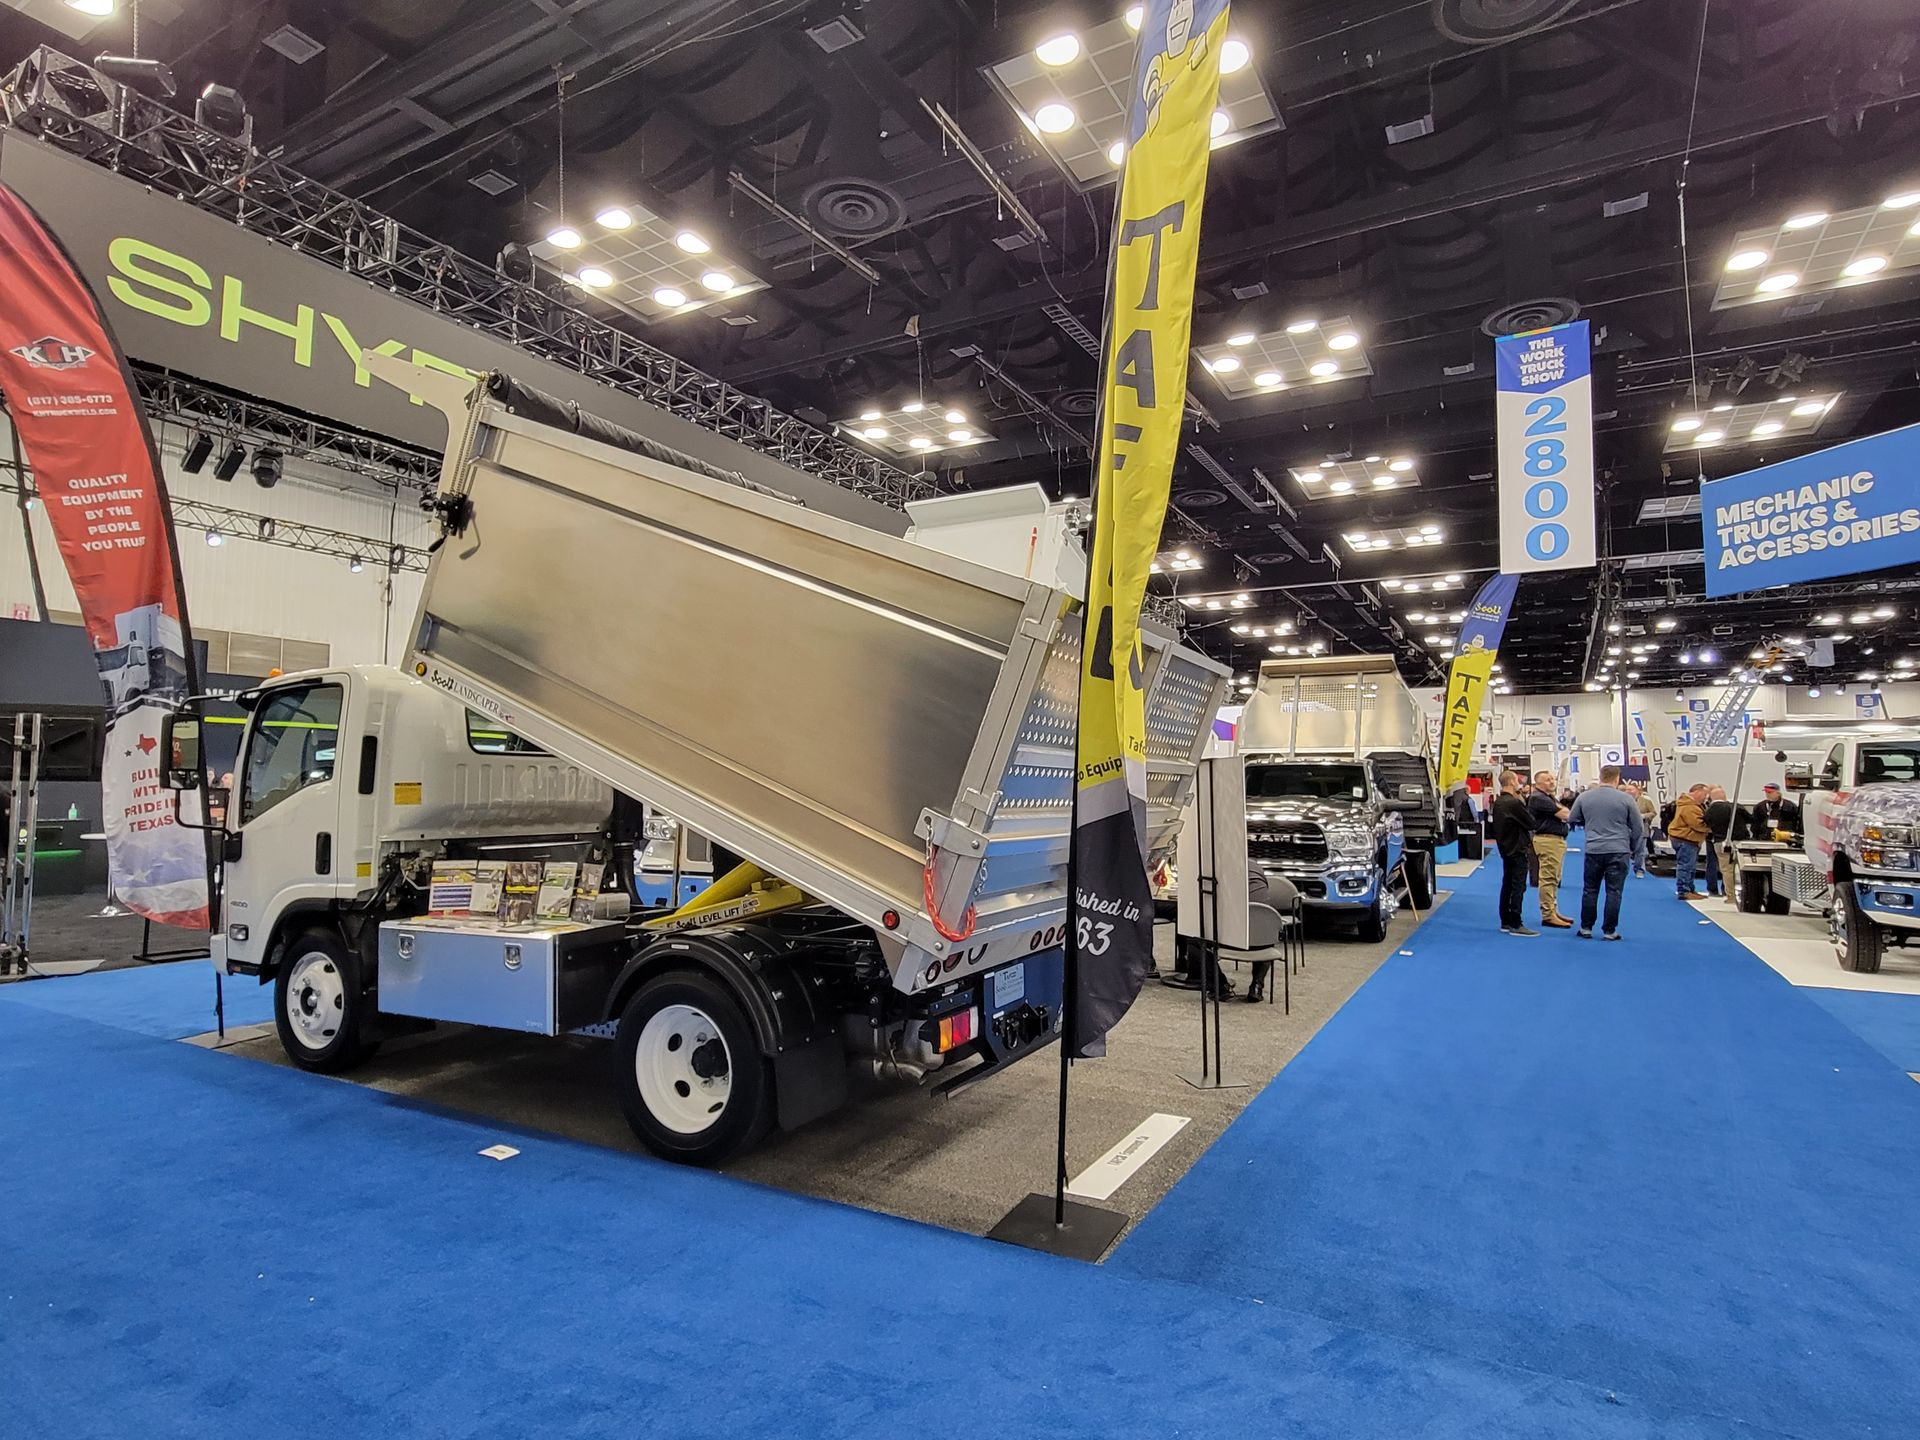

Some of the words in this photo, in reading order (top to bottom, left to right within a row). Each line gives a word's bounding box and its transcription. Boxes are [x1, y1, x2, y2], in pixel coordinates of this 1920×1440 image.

[1528, 337, 1555, 351] THE
[1520, 347, 1565, 363] WORK
[1520, 358, 1565, 375] TRUCK
[1521, 369, 1565, 387] SHOW
[68, 474, 128, 489] QUALITY
[1523, 396, 1570, 562] 2800
[61, 489, 143, 506] EQUIPMENT
[1716, 471, 1874, 527] MECHANIC
[85, 509, 104, 520] BY
[106, 506, 133, 517] THE
[88, 521, 141, 536] PEOPLE
[1717, 505, 1828, 547] TRUCKS
[1833, 500, 1858, 522] &
[81, 540, 112, 552] YOU
[115, 536, 146, 548] TRUST
[1718, 509, 1920, 570] ACCESSORIES
[453, 682, 499, 714] LANDSCAPER
[1557, 719, 1567, 752] 3600
[133, 785, 165, 798] WIT
[124, 801, 162, 818] PRIDE
[128, 814, 174, 832] TEXAS
[698, 911, 721, 924] LEVEL
[724, 906, 740, 918] LIFT
[1123, 900, 1140, 922] in
